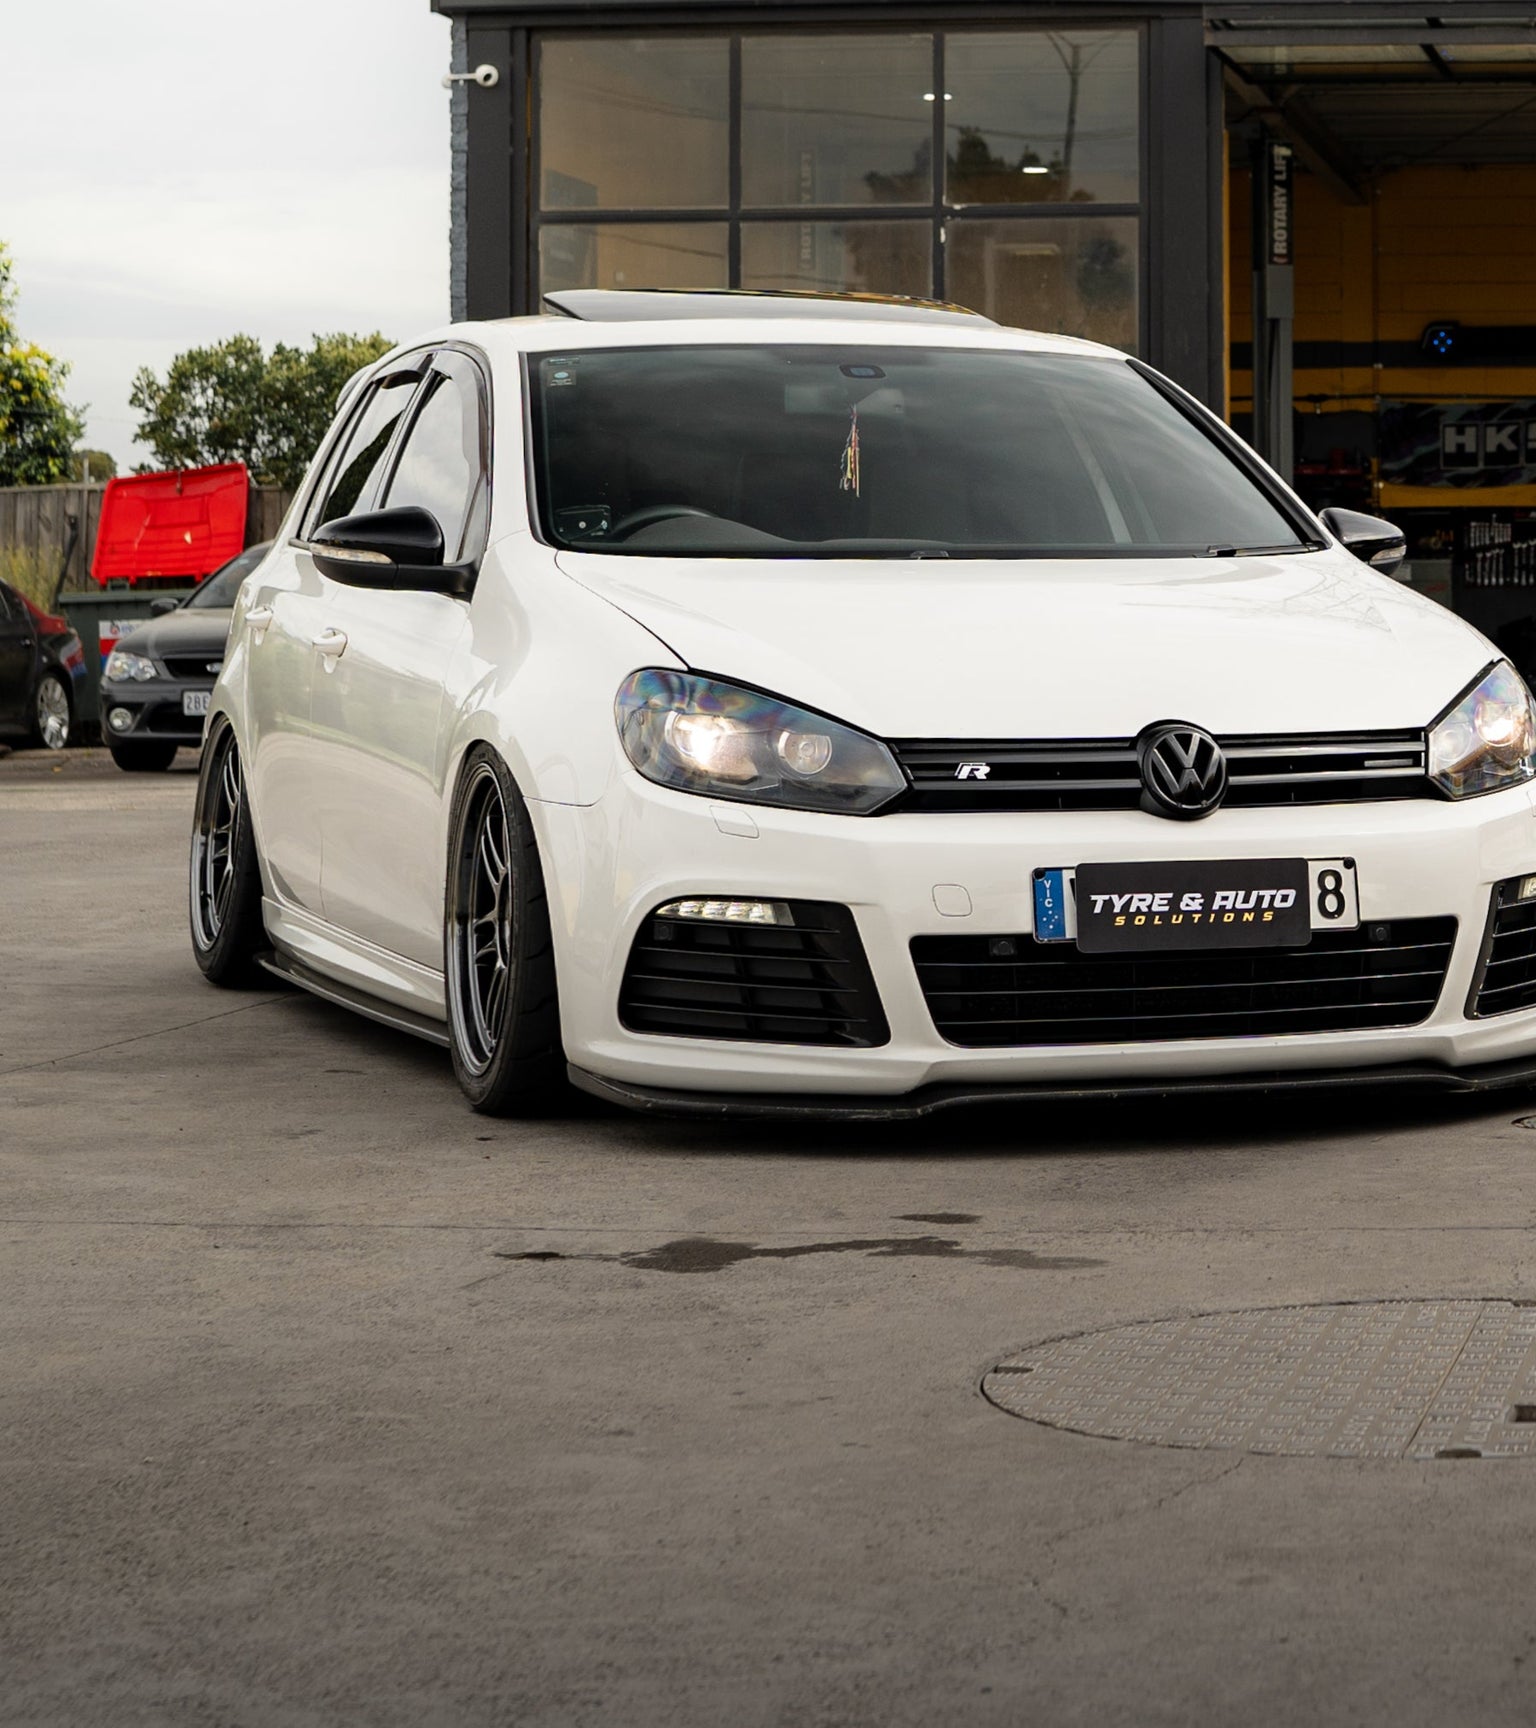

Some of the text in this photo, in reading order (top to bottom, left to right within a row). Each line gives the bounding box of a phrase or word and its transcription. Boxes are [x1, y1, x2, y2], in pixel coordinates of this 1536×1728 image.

[1273, 184, 1288, 255] ROTARY
[954, 762, 991, 779] R
[1043, 880, 1053, 908] VIC
[1090, 889, 1296, 914] TYRE & AUTO
[1316, 868, 1346, 919] 8
[1114, 911, 1274, 926] SOLUTIONS
